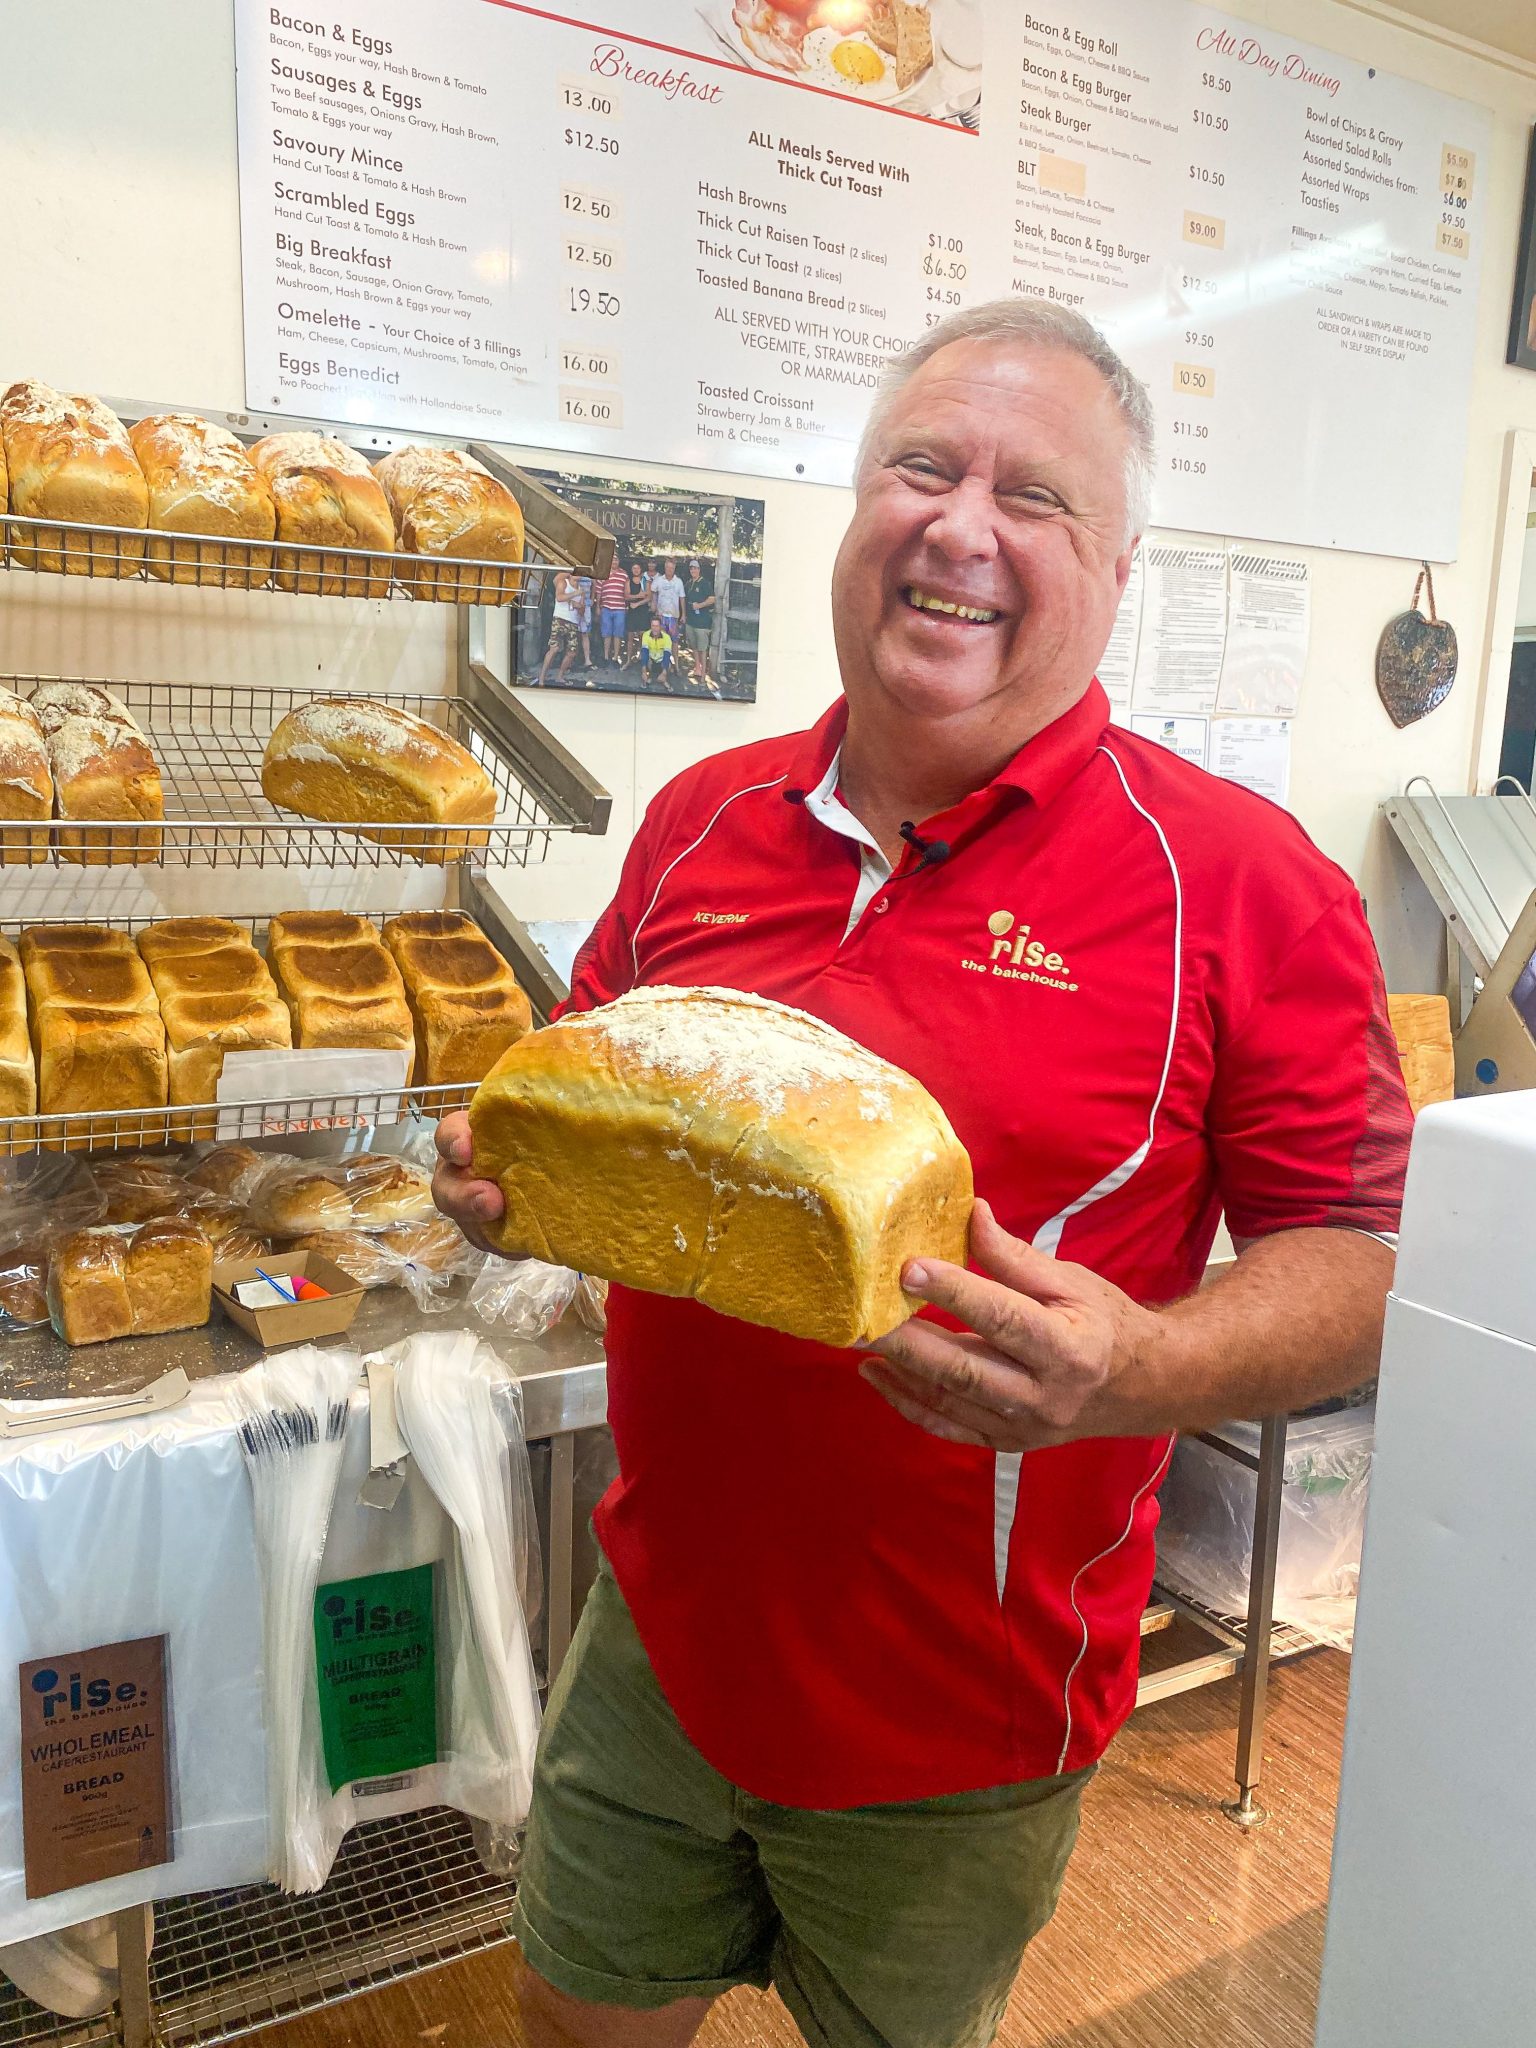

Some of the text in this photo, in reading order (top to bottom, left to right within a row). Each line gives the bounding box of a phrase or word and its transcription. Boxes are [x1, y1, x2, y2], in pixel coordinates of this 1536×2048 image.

[270, 7, 392, 55] Bacon & Eggs
[1024, 14, 1117, 56] Bacon & Egg Roll
[269, 32, 487, 95] Bacon, Eggs your way, Hash Brown & Tomato
[590, 43, 726, 104] Breakfast
[1197, 28, 1341, 97] All Day Dining
[270, 58, 422, 111] Sausages & Eggs
[1022, 57, 1132, 103] Bacon & Egg Burger
[1202, 72, 1231, 93] $8.50
[270, 83, 499, 146] Two Beef sausages, Onions Gravy, Hash Brown,
[1020, 99, 1091, 132] Steak Burger
[1193, 109, 1229, 131] $10.50
[1306, 107, 1403, 151] Bowl of Chips & Gravy
[272, 129, 403, 172] Savoury Mince
[565, 128, 620, 155] $12.50
[748, 130, 909, 182] ALL Meals Served With
[1304, 129, 1392, 166] Assorted Salad Rolls
[777, 159, 882, 197] Thick Cut Toast
[1017, 159, 1037, 176] BLT
[1189, 165, 1225, 186] $10.50
[1302, 150, 1417, 193] Assorted Sandwiches from:
[274, 181, 415, 227] Scrambled Eggs
[698, 180, 787, 214] Hash Browns
[1301, 192, 1339, 213] Toasties
[1190, 221, 1216, 239] $9.00
[1442, 212, 1466, 229] $9.50
[276, 232, 392, 269] Big Breakfast
[696, 210, 887, 265] Thick Cut Raisen Toast (2 slices)
[928, 234, 963, 253] $1.00
[1014, 219, 1150, 264] Steak, Bacon & Egg Burger
[923, 253, 967, 280] $6.50
[570, 286, 620, 316] 19.50
[696, 268, 886, 320] Toasted Banana Bread (2 Slices)
[926, 287, 961, 306] $4.50
[1011, 278, 1085, 306] Mince Burger
[277, 302, 361, 330] Omelette
[382, 323, 410, 338] Your
[413, 328, 455, 346] Choice
[458, 336, 470, 348] of
[473, 338, 481, 350] 3
[484, 339, 521, 358] fillings
[714, 306, 918, 355] ALL SERVED WITH YOUR CHOIC
[1185, 331, 1214, 347] $9.50
[277, 325, 528, 374] Ham, Cheese, Capsicum, Mushrooms, Tomato, Onion
[563, 355, 609, 374] 16.00
[740, 332, 888, 368] VEGEMITE, STRAWBERR
[1340, 339, 1406, 360] IN SELF SERVE DISPLAY
[279, 352, 400, 384] Eggs Benedict
[565, 401, 610, 419] 16.00
[697, 380, 814, 411] Toasted Croissant
[1173, 421, 1208, 438] $11.50
[1171, 458, 1206, 474] $10.50
[631, 513, 652, 532] DEN
[656, 516, 692, 536] HOTEL
[693, 912, 750, 924] KEVERNE
[987, 925, 1070, 975] rise.
[961, 959, 1079, 992] the bakehouse
[43, 1672, 148, 1718] rise.
[45, 1700, 148, 1727] the bakehouse
[31, 1723, 155, 1764] WHOLEMEAL
[63, 1771, 125, 1794] BREAD
